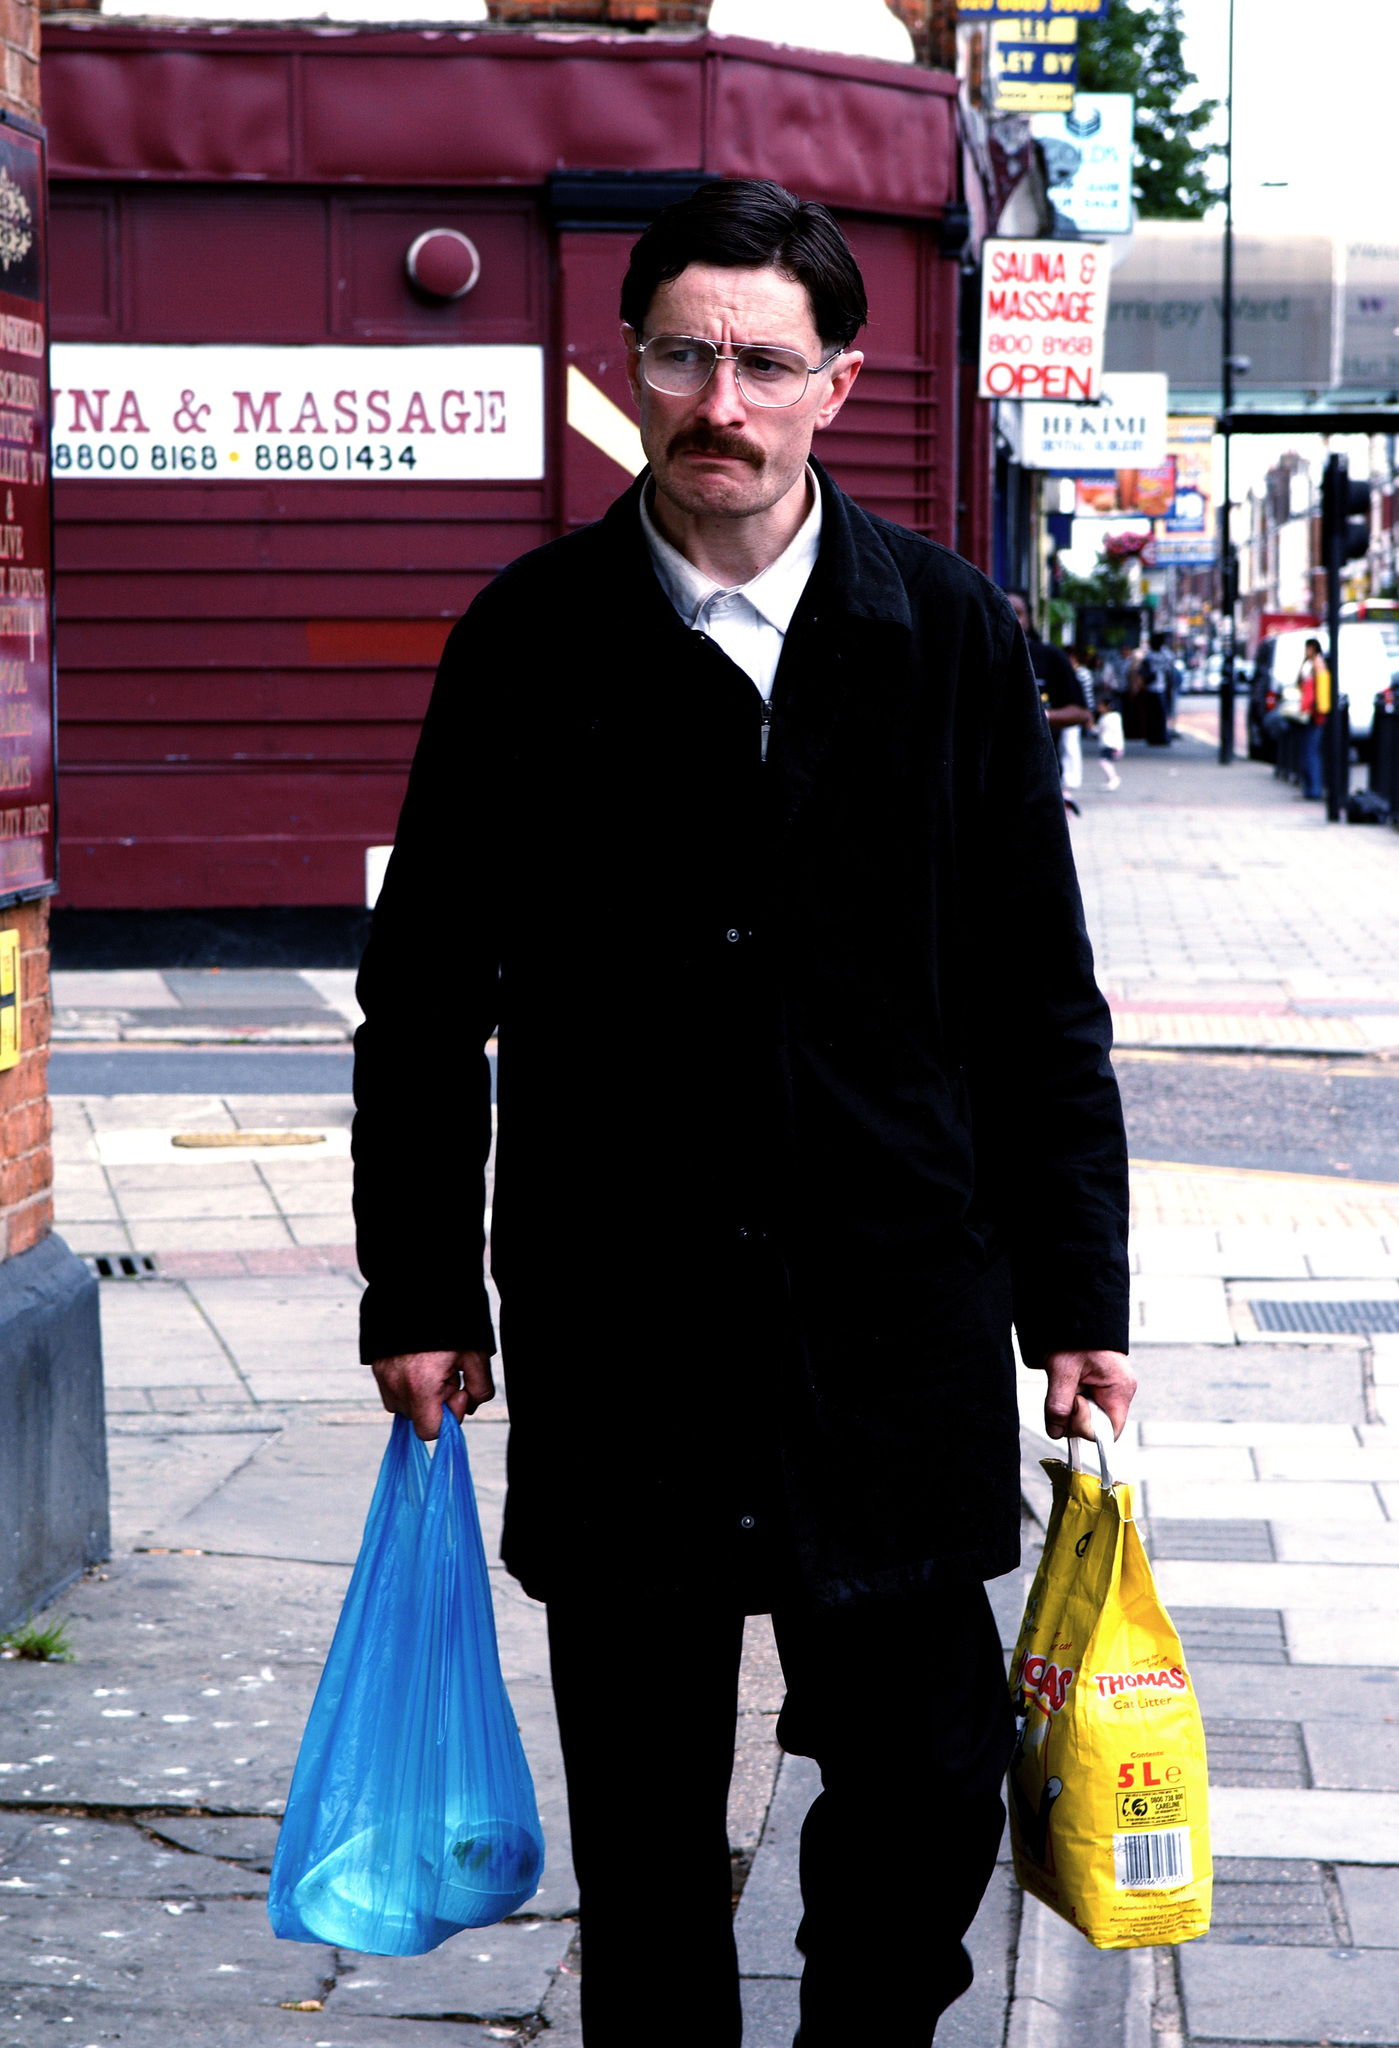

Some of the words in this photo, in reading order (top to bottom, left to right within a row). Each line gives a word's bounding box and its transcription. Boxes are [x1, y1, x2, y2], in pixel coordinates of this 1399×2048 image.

[992, 251, 1066, 283] SAUNA
[1079, 253, 1096, 284] &
[988, 290, 1096, 324] MASSAGE
[988, 333, 1032, 355] 800
[1042, 335, 1093, 356] 8168
[986, 362, 1092, 399] OPEN
[173, 389, 211, 434] &
[232, 390, 506, 434] MASSAGE
[151, 445, 217, 471] 8168
[255, 445, 417, 471] 88801434
[1095, 1667, 1185, 1697] THOMAS
[1113, 1700, 1135, 1710] Cat
[1138, 1697, 1172, 1709] Litter
